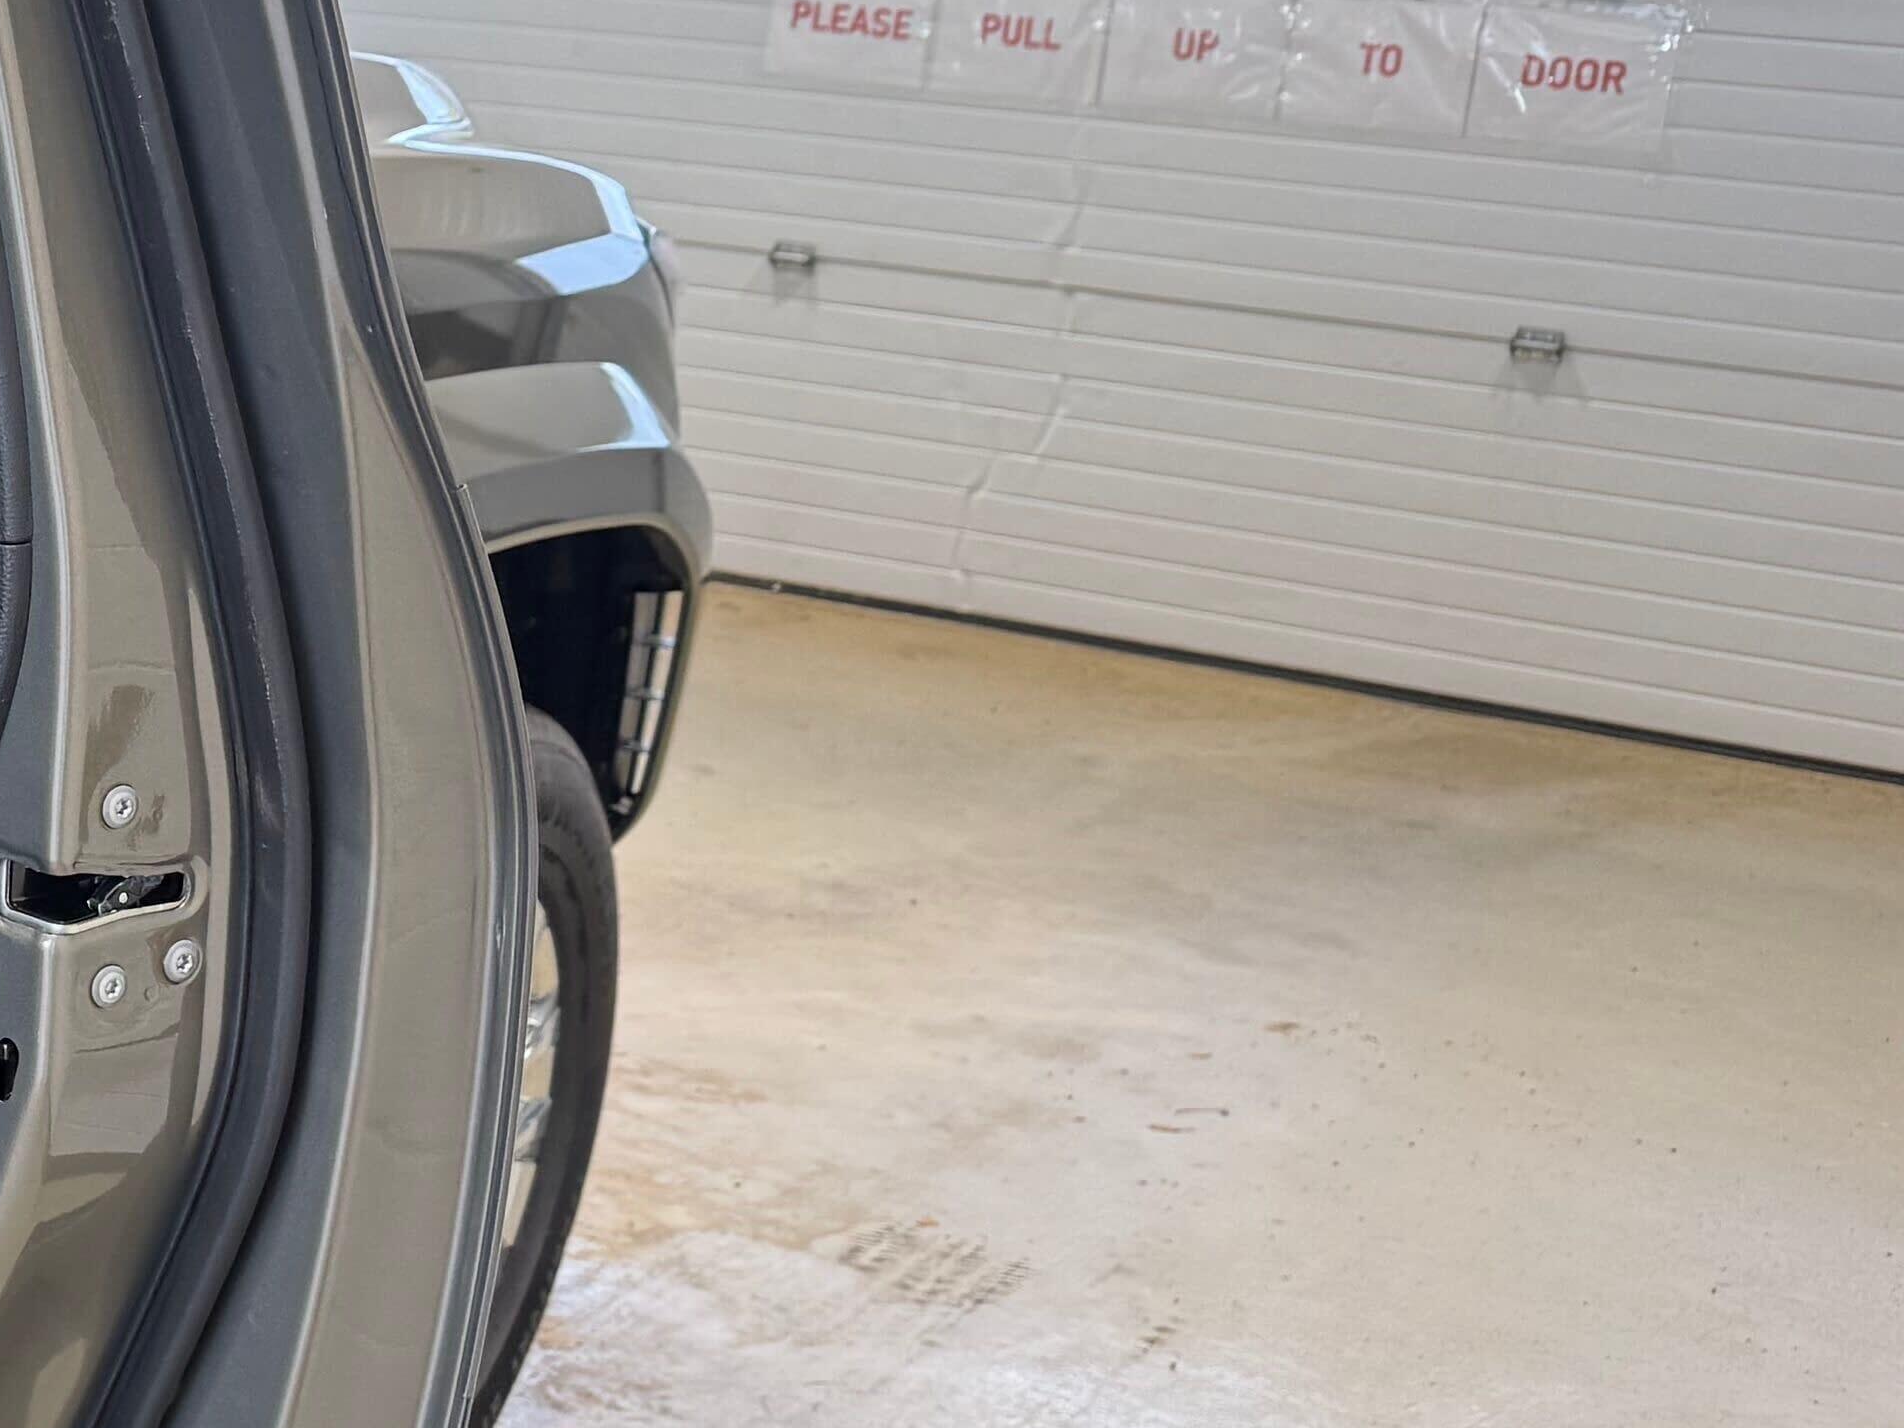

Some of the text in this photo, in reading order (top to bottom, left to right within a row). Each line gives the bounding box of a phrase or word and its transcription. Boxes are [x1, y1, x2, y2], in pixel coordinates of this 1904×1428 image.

[791, 0, 1629, 97] PLEASE PULL UP TO DOOR
